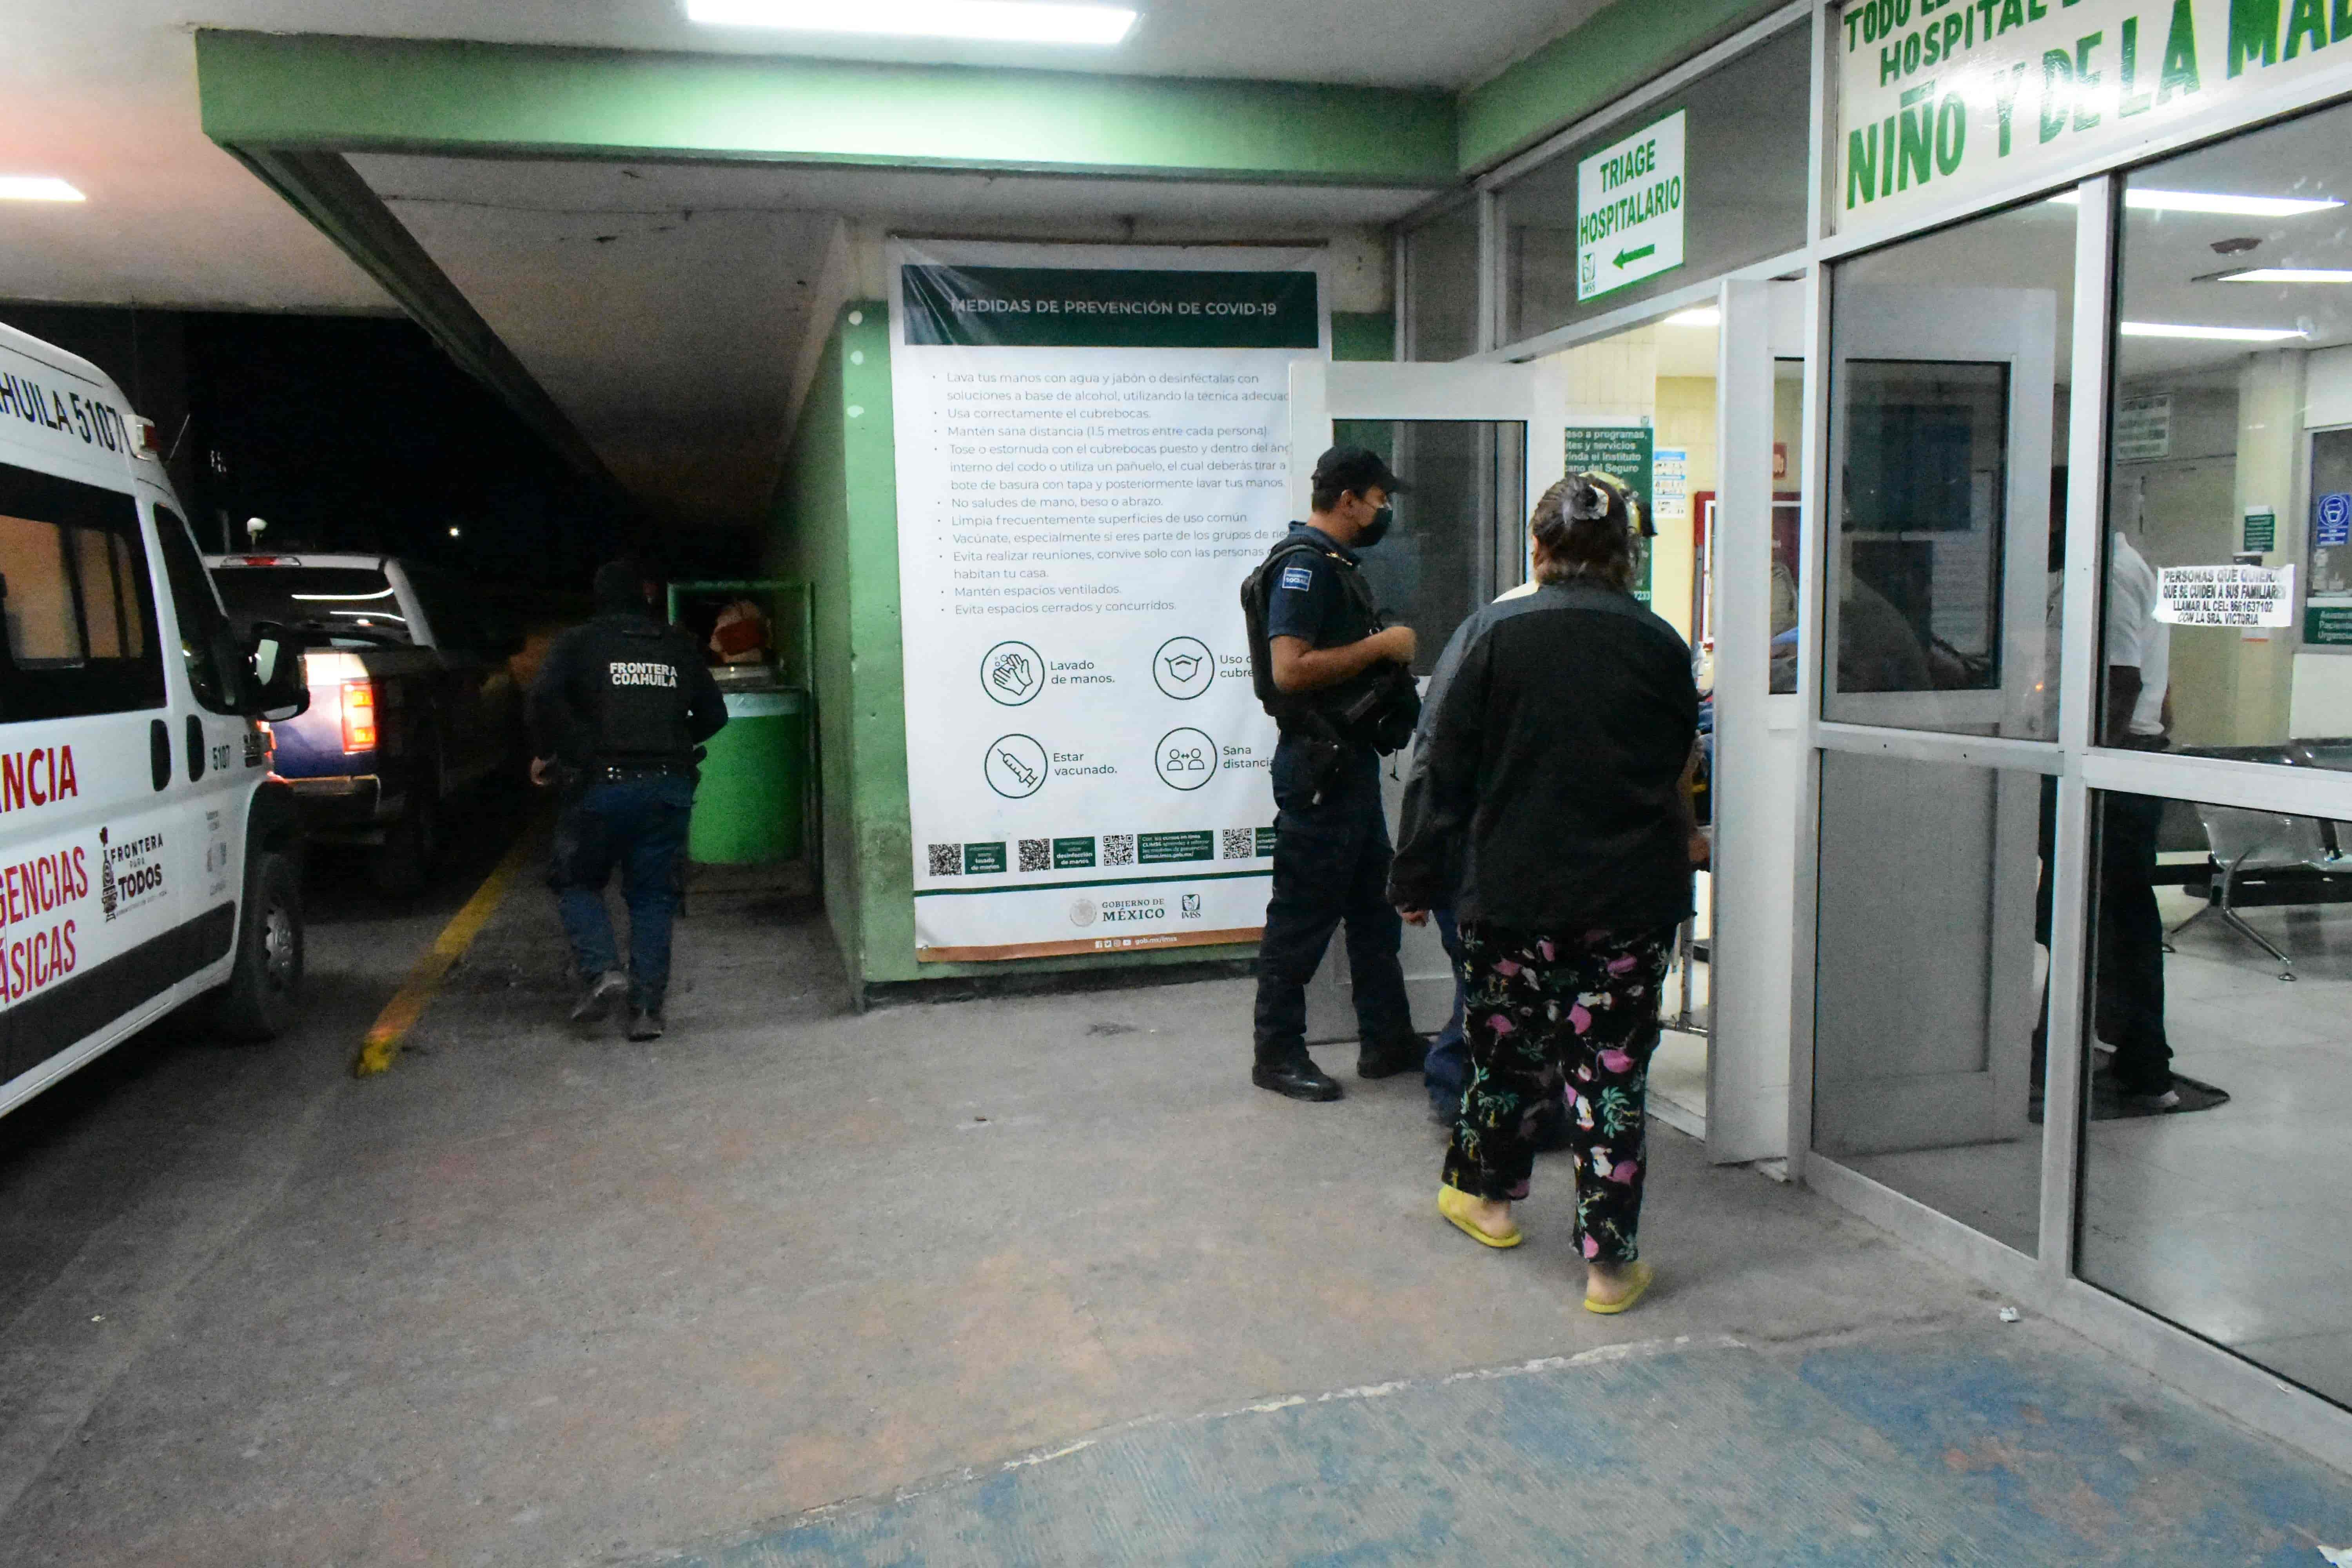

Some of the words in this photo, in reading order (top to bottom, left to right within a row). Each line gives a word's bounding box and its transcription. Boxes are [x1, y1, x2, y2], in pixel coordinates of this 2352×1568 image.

[1844, 0, 1911, 53] TODO
[1880, 0, 2047, 87] HOSPITAL
[1846, 78, 1966, 210] NIÑO
[1994, 62, 2025, 158] Y
[2040, 29, 2103, 145] DE
[2118, 0, 2201, 120] LA
[1600, 139, 1656, 192] TRIAGE
[1580, 175, 1680, 247] HOSPITALARIO
[951, 298, 1031, 314] MEDIDAS
[1036, 299, 1060, 314] DE
[1064, 299, 1173, 315] PREVENCIÓN
[1178, 302, 1200, 315] DE
[1205, 302, 1277, 316] COVID-19
[947, 373, 974, 382] Lava
[978, 373, 996, 383] tus
[1070, 375, 1099, 385] agua
[1112, 373, 1145, 385] jabón
[1159, 373, 1234, 383] desinféctalas
[947, 390, 1011, 401] soluciones
[1025, 391, 1053, 401] base
[1056, 391, 1071, 400] de
[1075, 390, 1120, 401] alcohol,
[1123, 391, 1181, 401] utilizando
[1185, 391, 1194, 401] la
[1198, 391, 1238, 401] técnica
[0, 372, 74, 434] HUILA
[69, 392, 124, 454] 5107
[948, 408, 970, 418] Usa
[974, 410, 1063, 419] correctamente
[1066, 408, 1076, 418] el
[1080, 408, 1151, 418] cubrebocas.
[948, 427, 994, 436] Mantén
[1029, 426, 1083, 436] distancia
[1108, 427, 1149, 436] metros
[1152, 428, 1183, 436] entre
[1186, 426, 1213, 436] cada
[949, 444, 975, 454] Tose
[989, 444, 1048, 454] estornuda
[1076, 443, 1086, 454] el
[1090, 444, 1157, 454] cubrebocas
[1160, 445, 1198, 455] puesto
[1210, 443, 1248, 453] dentro
[1252, 443, 1268, 453] del
[1593, 440, 1637, 450] servicios
[1602, 452, 1641, 461] Instituto
[951, 462, 993, 472] interno
[996, 462, 1013, 472] del
[1017, 461, 1046, 472] codo
[1060, 461, 1093, 472] utiliza
[1116, 461, 1165, 473] pañuelo,
[1168, 461, 1177, 471] el
[1180, 461, 1203, 471] cual
[1207, 460, 1252, 470] deberás
[1255, 462, 1276, 470] tirar
[1604, 463, 1639, 474] Seguro
[951, 480, 977, 490] bote
[981, 480, 996, 490] de
[1000, 480, 1039, 489] basura
[1067, 481, 1093, 491] tapa
[1106, 480, 1194, 491] posteriormente
[1197, 478, 1221, 488] lavar
[952, 499, 969, 508] No
[972, 497, 1018, 508] saludes
[1021, 497, 1036, 507] de
[1040, 499, 1077, 508] mano,
[1080, 497, 1108, 507] beso
[1122, 496, 1163, 506] abrazo.
[952, 515, 993, 527] Limpia
[996, 515, 1095, 525] frecuentemente
[1098, 513, 1163, 526] superficies
[1166, 513, 1180, 523] de
[953, 534, 1011, 544] Vacúnate,
[1014, 532, 1101, 544] especialmente
[1143, 532, 1173, 543] parte
[1176, 531, 1191, 540] de
[1194, 530, 1209, 540] los
[1212, 532, 1251, 542] grupos
[1254, 530, 1269, 539] de
[954, 552, 982, 561] Evita
[987, 550, 1028, 561] realizar
[1033, 550, 1094, 560] reuniones,
[1097, 549, 1141, 559] convive
[1145, 548, 1167, 558] solo
[1171, 550, 1191, 558] con
[1195, 548, 1210, 557] las
[1214, 549, 1265, 559] personas
[954, 569, 1000, 579] habitan
[1004, 570, 1016, 578] tu
[2164, 570, 2214, 583] PERSONAS
[2217, 569, 2238, 583] QUE
[955, 587, 1000, 597] Mantén
[1004, 585, 1056, 598] espacios
[1058, 584, 1121, 595] ventilados.
[2163, 585, 2177, 599] QUE
[2178, 585, 2188, 599] SE
[2189, 585, 2216, 599] CUIDEN
[2225, 584, 2239, 599] SUS
[955, 605, 984, 615] Evita
[987, 603, 1038, 616] espacios
[1042, 602, 1093, 613] cerrados
[1105, 600, 1176, 611] concurridos.
[2173, 601, 2200, 612] LLAMAR
[2203, 601, 2210, 612] AL
[2213, 601, 2229, 612] CEL:
[2178, 612, 2194, 623] CON
[2195, 612, 2205, 623] LA
[2206, 612, 2222, 624] SRA.
[2225, 613, 2258, 625] VICTORIA
[1050, 660, 1094, 671] Lavado
[1220, 654, 1242, 664] Uso
[610, 662, 678, 677] FRONTERA
[1220, 667, 1254, 678] cubre
[612, 673, 677, 688] COAHUILA
[1051, 674, 1067, 684] de
[1070, 675, 1115, 684] manos.
[1223, 745, 1252, 755] Sana
[212, 745, 230, 771] 5107
[1053, 752, 1084, 762] Estar
[1054, 765, 1118, 777] vacunado.
[0, 744, 78, 813] NCIA
[110, 833, 164, 865] FRONTERA
[118, 863, 163, 901] TODOS
[1102, 899, 1150, 909] GOBIERNO
[1103, 908, 1165, 922] MÉXICO
